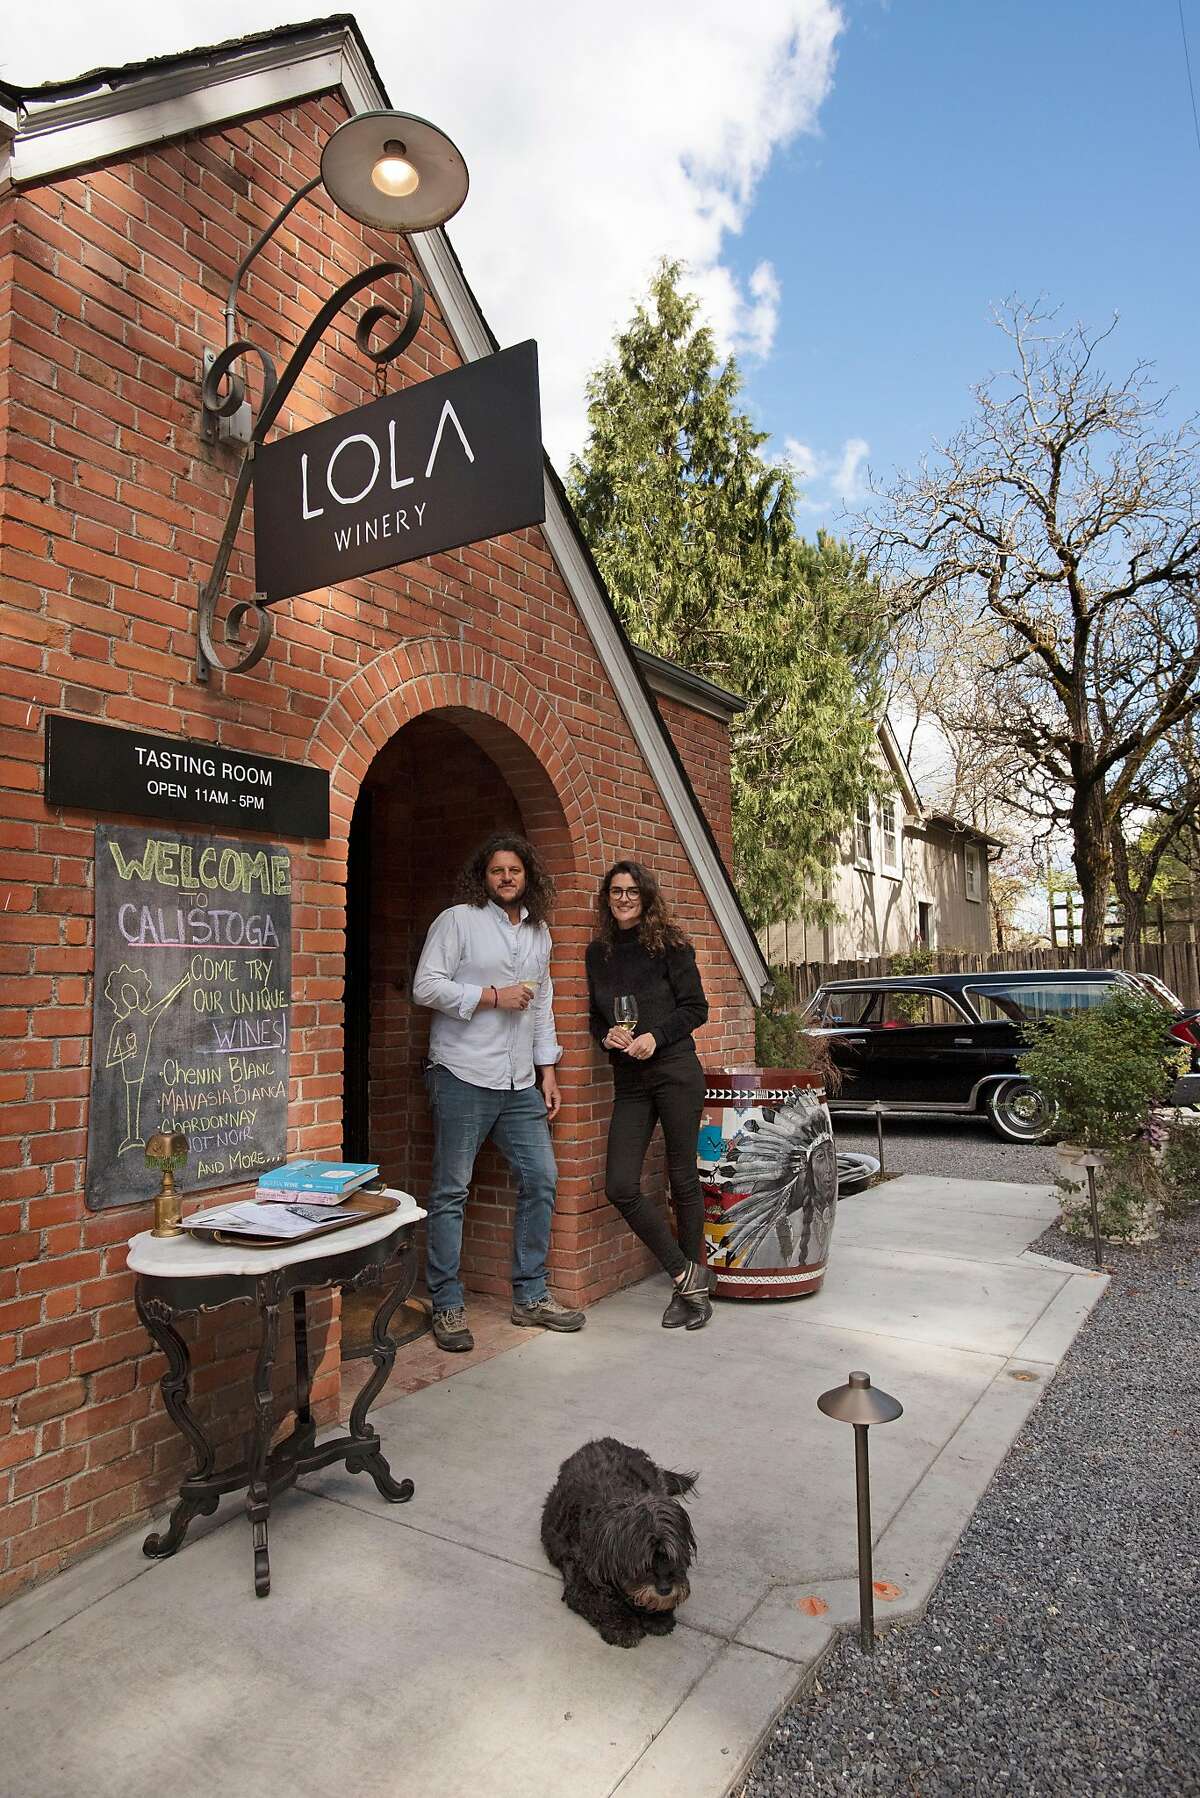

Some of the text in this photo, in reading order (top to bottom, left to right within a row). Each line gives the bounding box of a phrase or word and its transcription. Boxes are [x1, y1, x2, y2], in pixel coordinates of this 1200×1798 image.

[302, 400, 474, 519] LOLA
[334, 502, 426, 551] WINERY
[134, 747, 272, 787] TASTING ROOM
[147, 780, 187, 798] OPEN
[195, 788, 228, 805] 11AM
[239, 795, 264, 810] 5PM
[108, 839, 291, 895] WELCOME
[178, 892, 209, 908] TO
[118, 903, 280, 947] CALISTOGA
[191, 954, 273, 987] COME TRY
[193, 987, 288, 1014] OUR UNIQUE
[212, 1012, 287, 1055] WINES!
[217, 1126, 253, 1146] NOIR
[197, 1161, 225, 1179] AND
